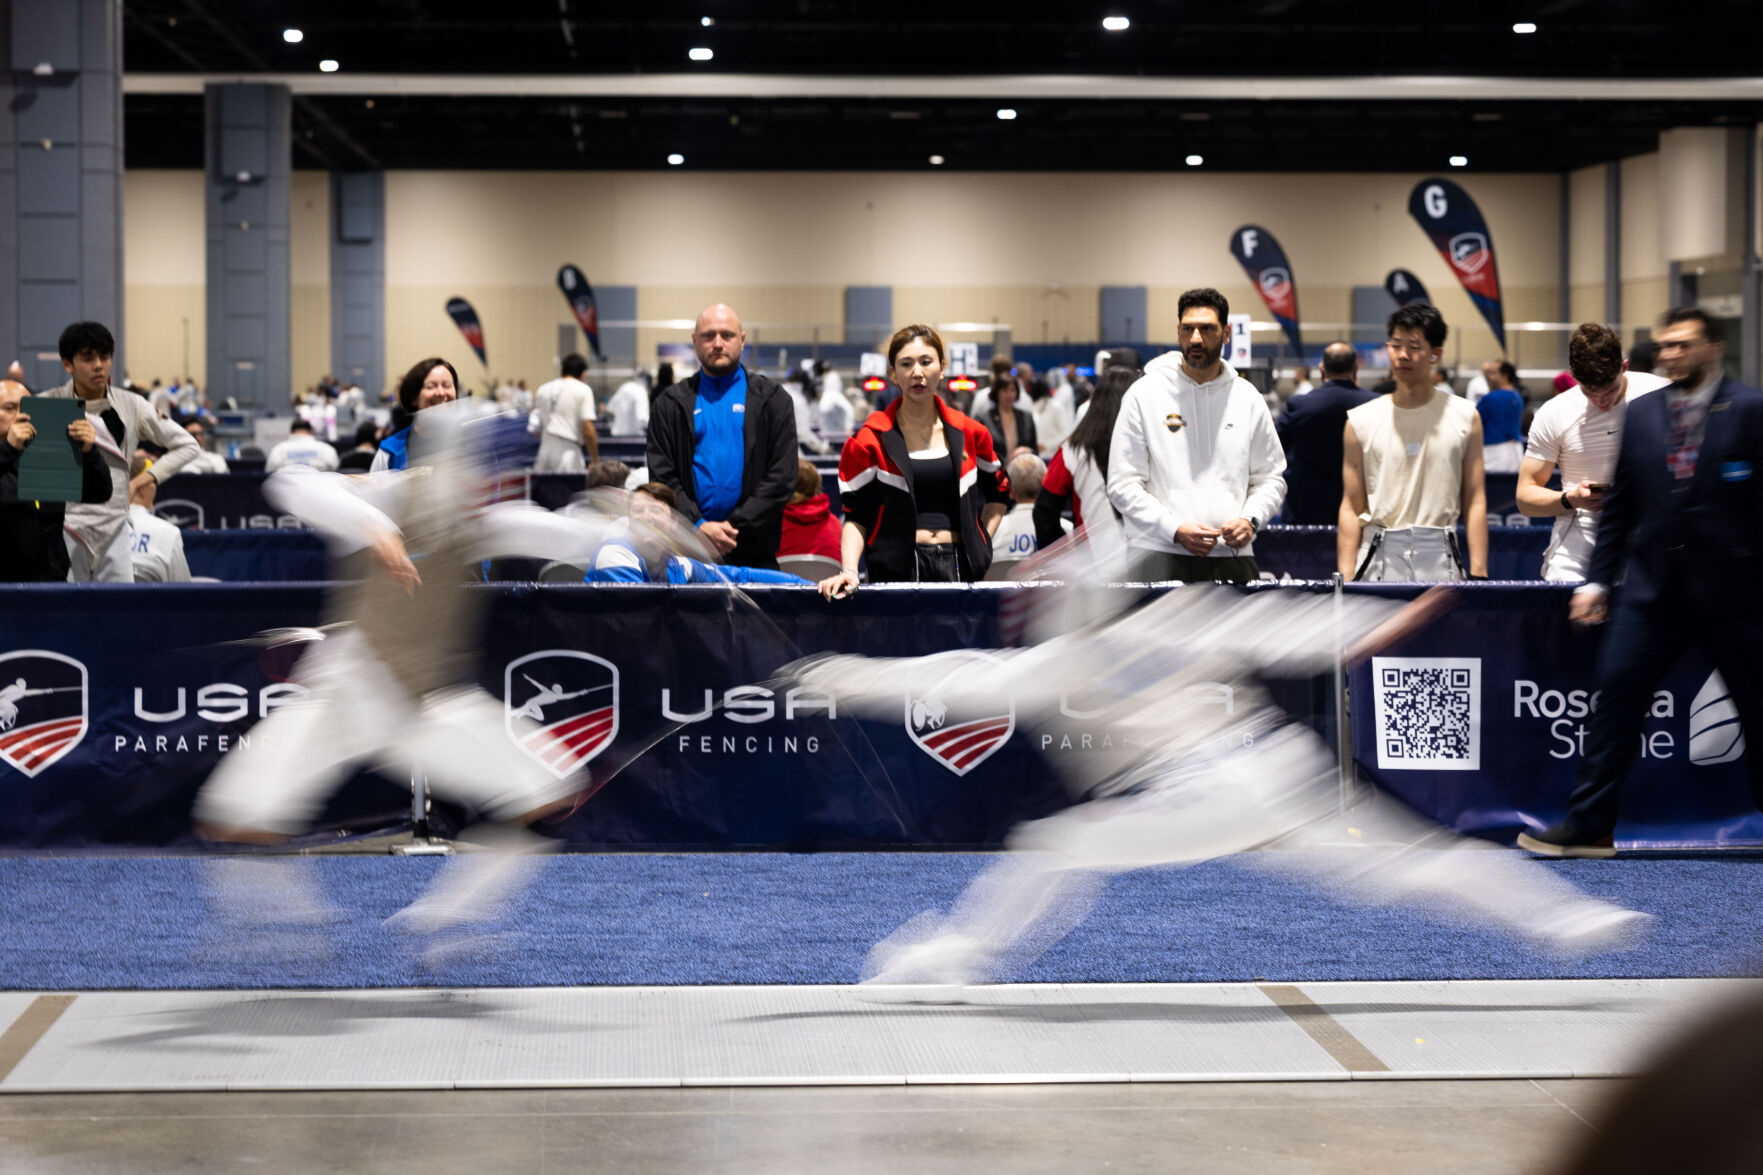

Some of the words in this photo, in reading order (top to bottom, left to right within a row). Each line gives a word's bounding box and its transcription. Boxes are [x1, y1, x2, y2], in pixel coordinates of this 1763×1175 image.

[1424, 184, 1448, 219] G
[1241, 229, 1259, 258] F
[1393, 272, 1409, 293] A
[1236, 323, 1245, 335] 1
[134, 682, 309, 722] USA
[661, 685, 837, 723] USA
[1514, 680, 1674, 718] Rosa
[679, 736, 819, 753] FENCING
